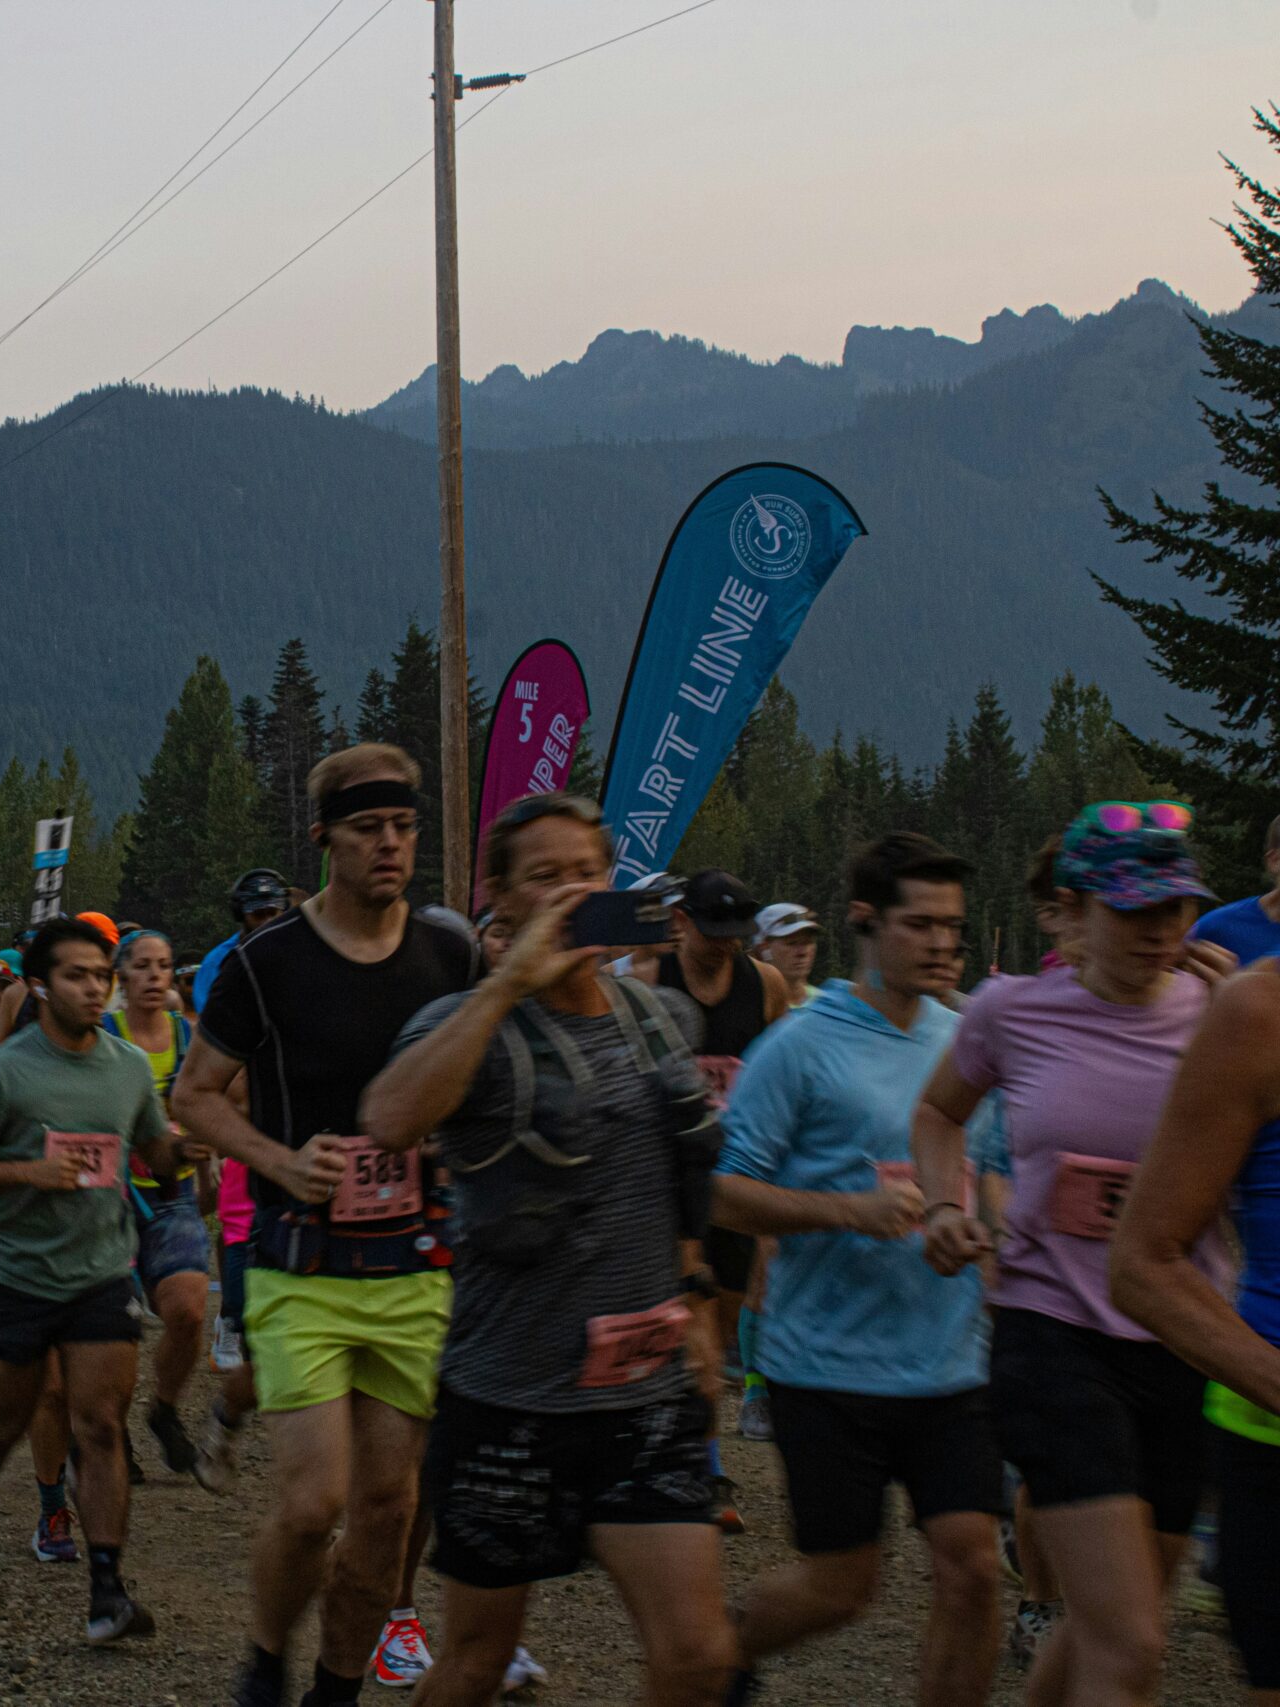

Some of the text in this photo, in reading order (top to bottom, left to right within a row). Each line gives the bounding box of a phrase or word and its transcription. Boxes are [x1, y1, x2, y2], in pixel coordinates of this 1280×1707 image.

[514, 680, 539, 701] MILE
[518, 702, 533, 743] 5
[609, 575, 769, 889] TART LINE
[524, 713, 575, 796] PER
[357, 1151, 406, 1185] 589
